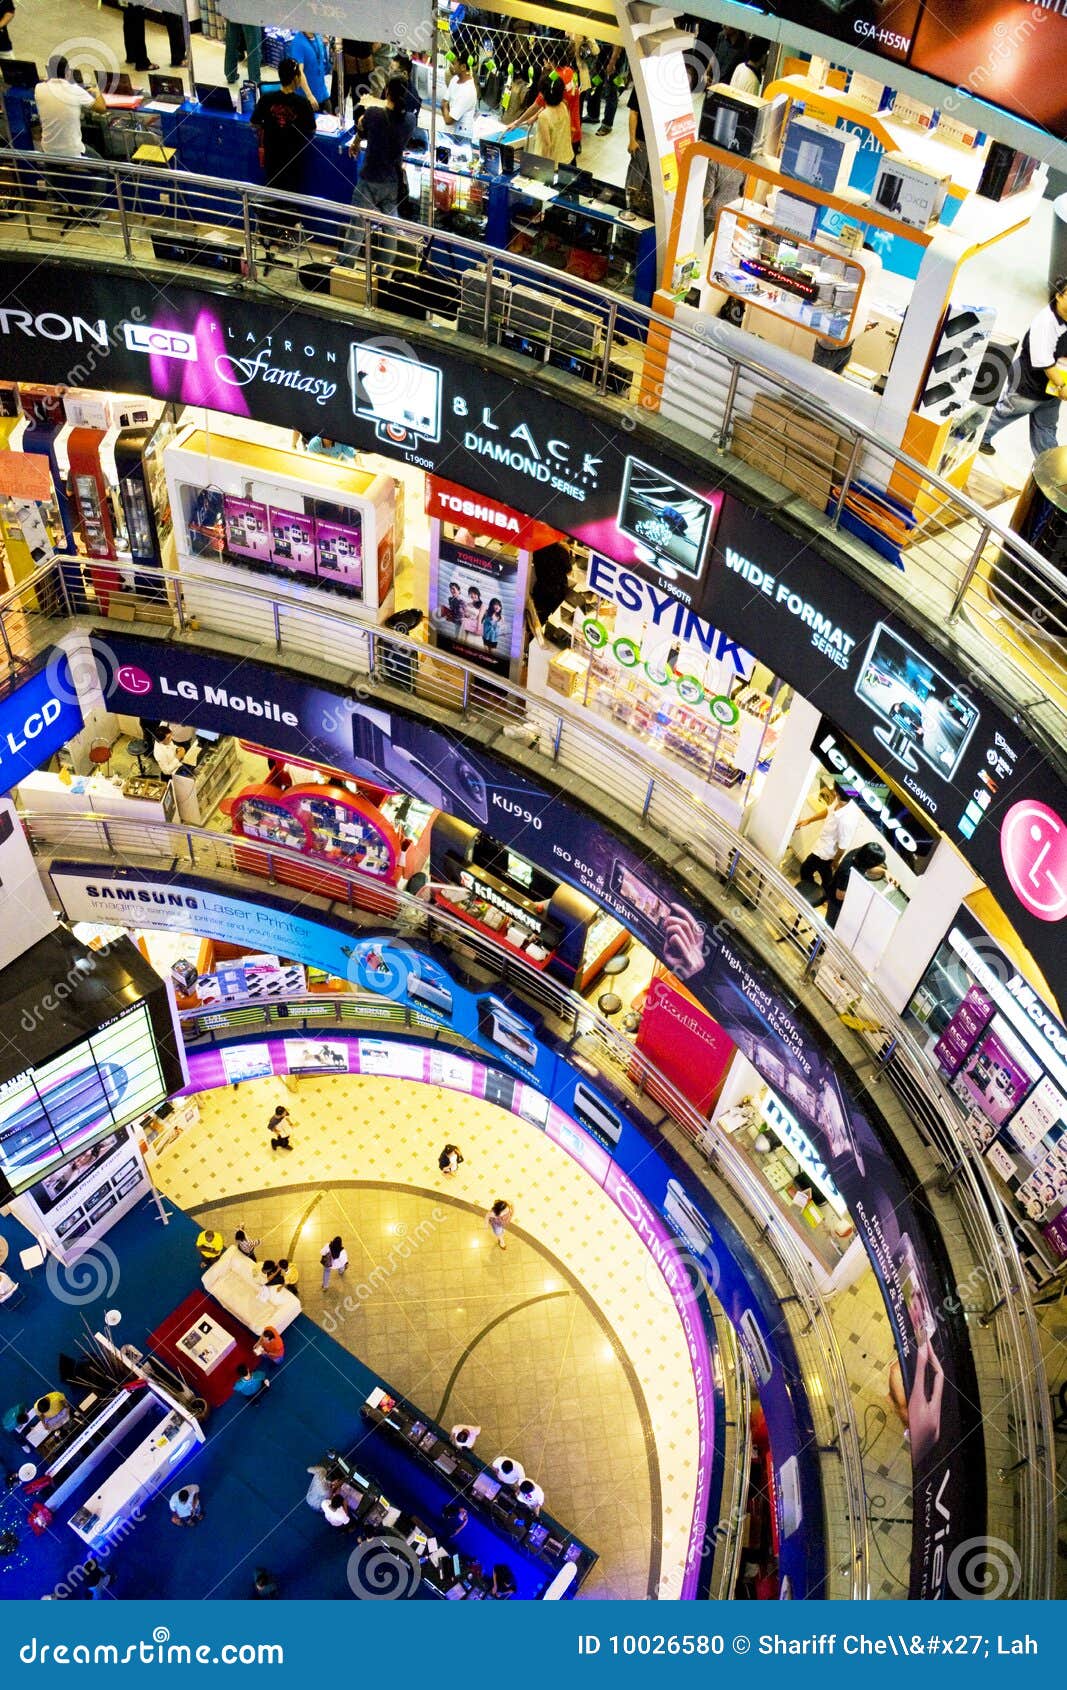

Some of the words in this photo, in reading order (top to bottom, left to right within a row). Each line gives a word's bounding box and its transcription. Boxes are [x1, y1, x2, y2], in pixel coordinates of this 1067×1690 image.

[853, 19, 911, 53] GSA-H55N
[130, 329, 191, 354] LCD
[209, 322, 337, 363] FLATRON
[214, 349, 337, 406] Fantasy
[405, 451, 434, 470] L1900R
[452, 396, 603, 477] BLACK
[464, 432, 551, 483] DIAMOND
[550, 476, 587, 502] SERIES
[437, 492, 521, 534] TOSHIBA
[457, 551, 493, 569] TOSHIBA
[589, 554, 747, 676] ESYINK
[657, 576, 693, 604] L1960TR
[725, 547, 775, 595] WIDE
[775, 585, 856, 653] FORMAT
[810, 632, 850, 671] SERIES
[6, 698, 62, 755] LCD
[159, 676, 199, 701] LG
[203, 685, 299, 727] Mobile
[492, 792, 543, 831] KU990
[819, 734, 918, 852] lenovo
[902, 774, 938, 814] L226WTQ
[553, 845, 572, 863] ISO
[573, 859, 594, 878] 800
[595, 874, 605, 885] &
[85, 884, 199, 910] SAMSUNG
[202, 898, 253, 920] Laser
[256, 911, 311, 937] Printer
[720, 946, 773, 1007] High-speed
[772, 1004, 804, 1048] 120fps
[1004, 973, 1067, 1062] Micros
[741, 979, 767, 1015] Video
[767, 1012, 813, 1076] Recording
[855, 1200, 891, 1285] Recognition
[893, 1301, 911, 1358] Editing
[871, 1214, 906, 1301] Handwriting
[931, 1468, 950, 1600] Vie
[920, 1573, 928, 1600] ne
